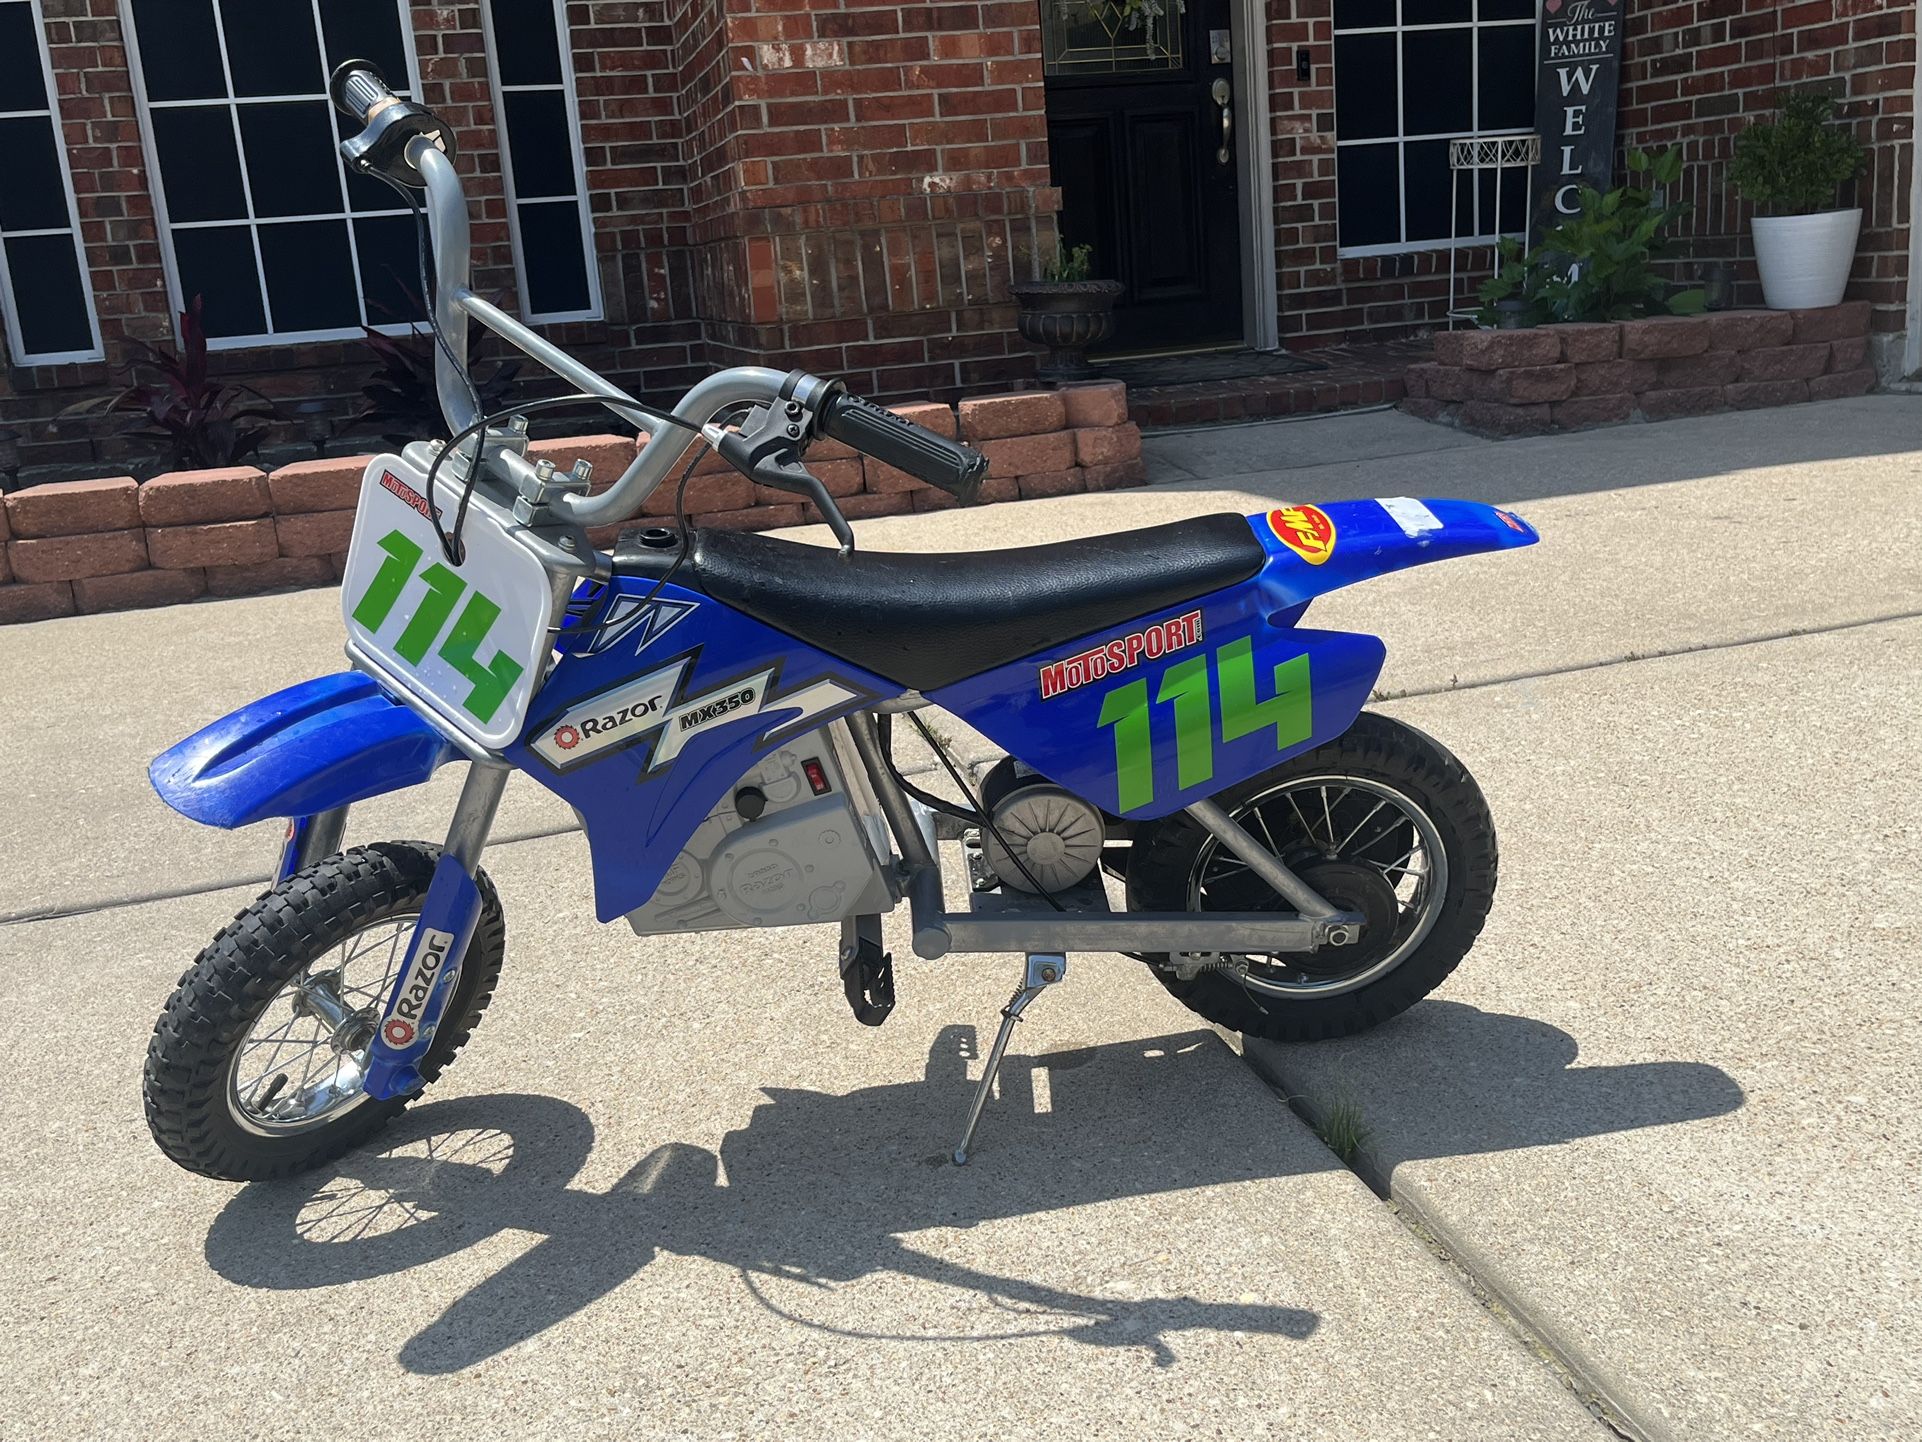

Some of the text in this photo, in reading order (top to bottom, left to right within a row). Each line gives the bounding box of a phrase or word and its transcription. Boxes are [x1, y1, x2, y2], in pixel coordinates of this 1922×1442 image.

[1547, 20, 1615, 43] WHITE
[1566, 0, 1597, 25] The
[1550, 39, 1610, 58] FAMILY
[351, 528, 525, 725] 114
[580, 694, 664, 740] Razor
[678, 687, 757, 733] MX350
[1096, 634, 1313, 815] 114
[396, 934, 448, 1021] Razor
